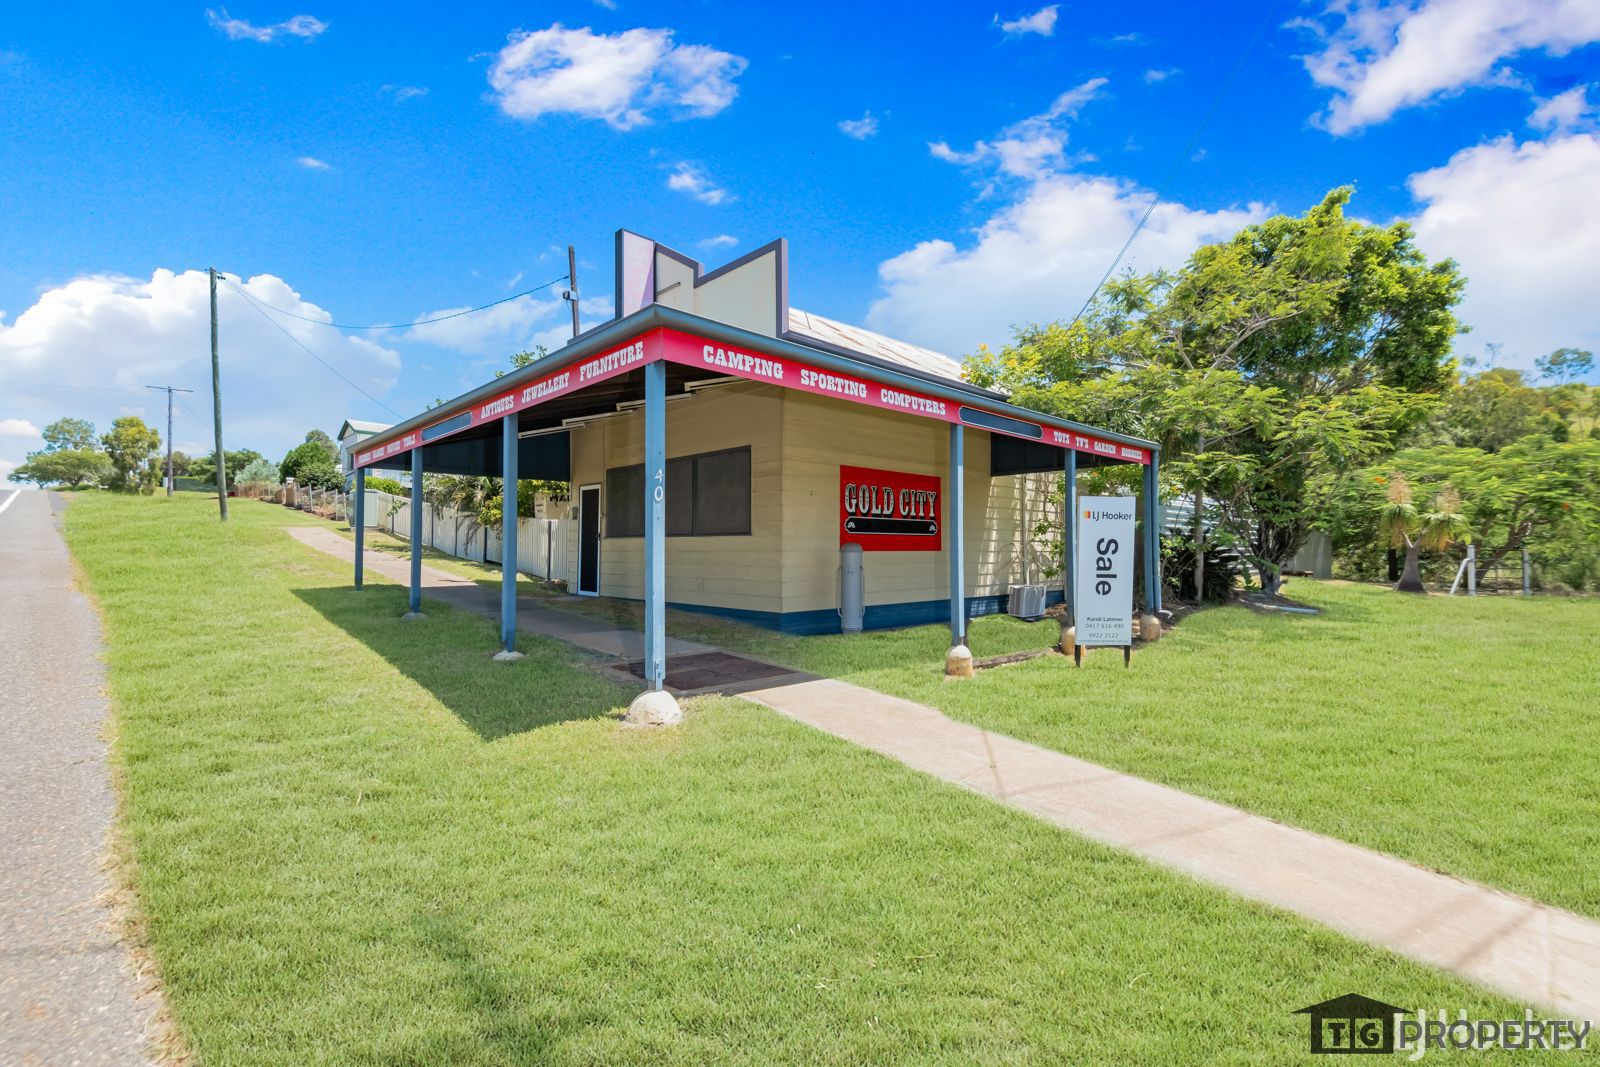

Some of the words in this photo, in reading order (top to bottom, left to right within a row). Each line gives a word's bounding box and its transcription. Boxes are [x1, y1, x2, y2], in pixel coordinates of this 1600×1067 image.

[481, 394, 514, 419] ANTIQUES
[521, 372, 570, 404] JEWELLERY
[579, 341, 644, 382] FURNITURE
[703, 345, 784, 379] CAMPING
[800, 369, 868, 399] SPORTING
[880, 388, 947, 416] COMPUTERS
[1053, 431, 1070, 444] TOYS
[1075, 436, 1088, 449] TV'S
[1094, 441, 1116, 455] GARDEN
[654, 468, 664, 502] 40
[844, 483, 895, 517] GOLD
[899, 488, 937, 519] CITY
[1092, 511, 1100, 521] LJ
[1102, 511, 1132, 520] Hooker
[1095, 537, 1119, 596] Sale
